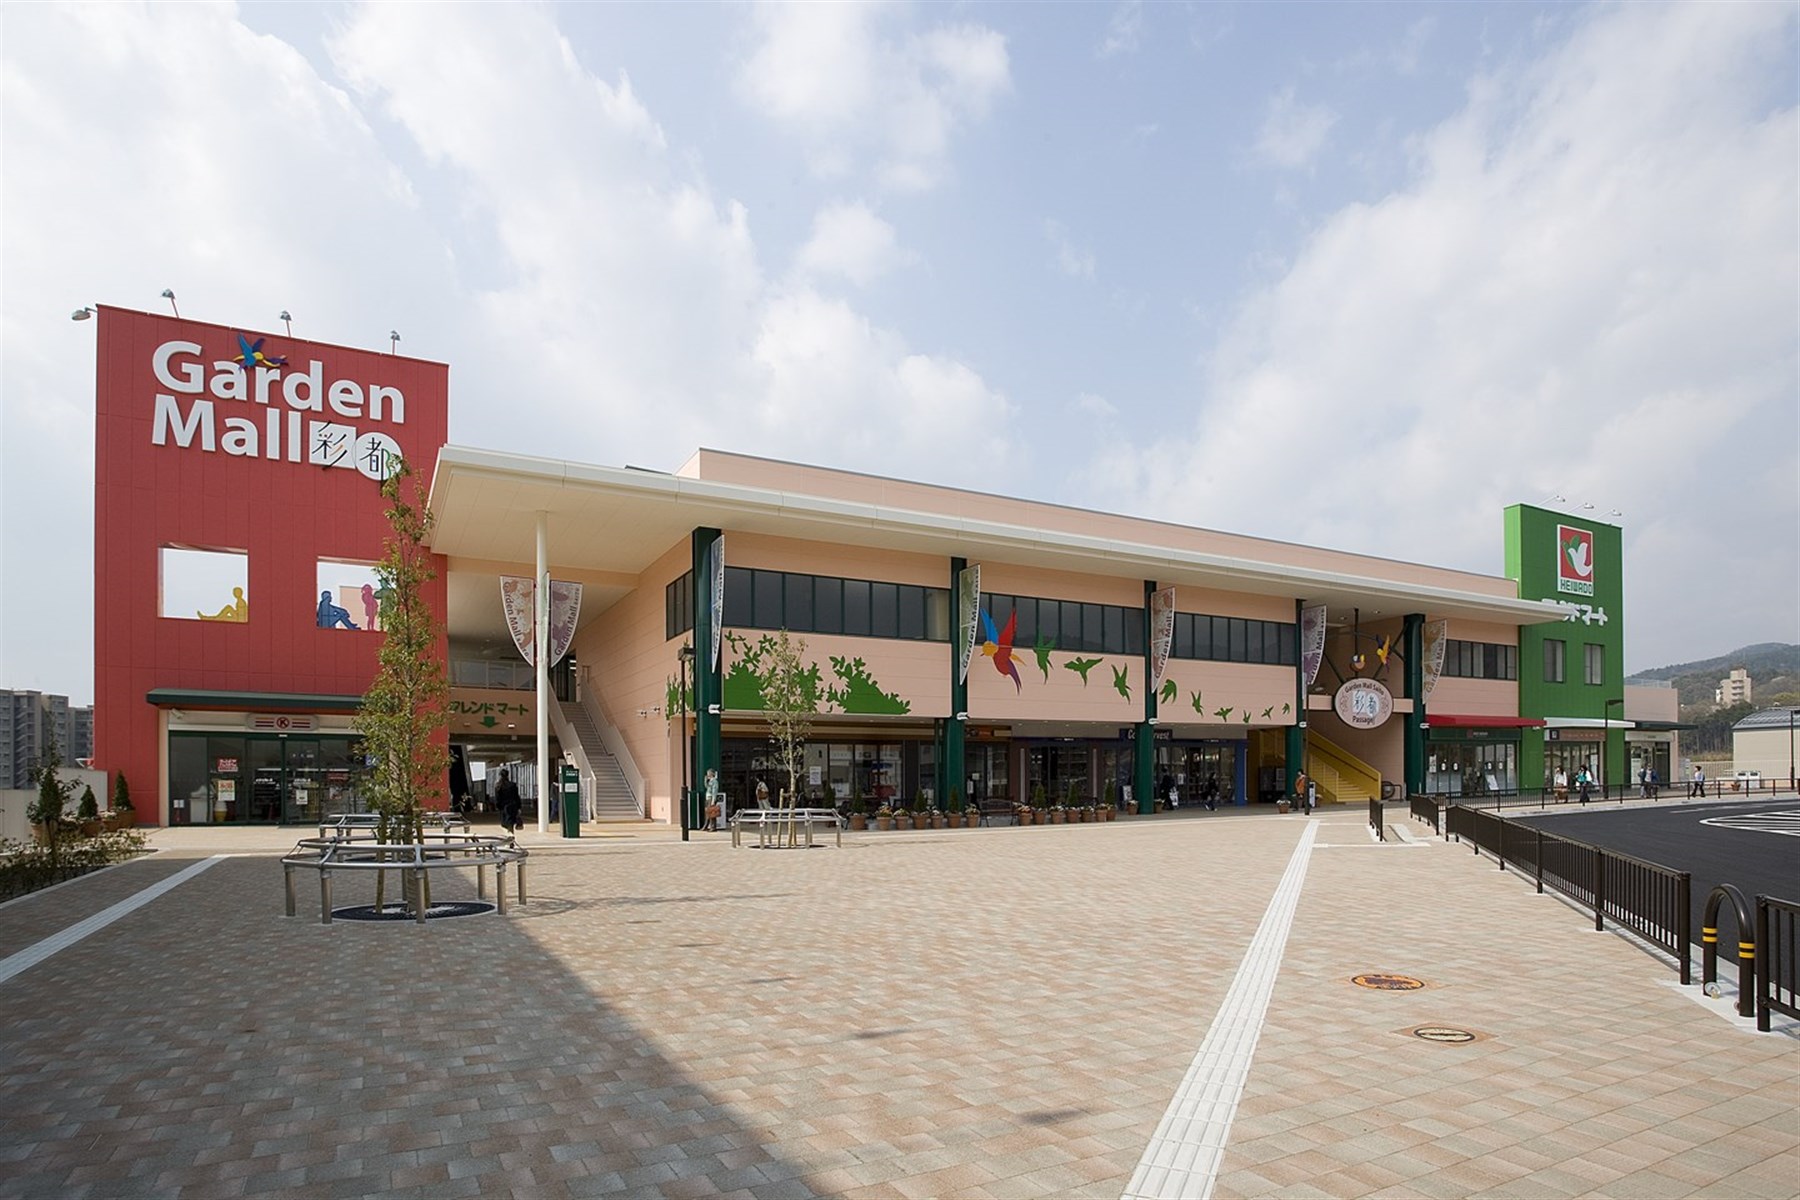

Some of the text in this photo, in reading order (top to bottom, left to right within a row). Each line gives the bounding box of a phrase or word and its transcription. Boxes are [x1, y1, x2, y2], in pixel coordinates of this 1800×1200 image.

[152, 340, 404, 424] Garden
[152, 393, 398, 486] Mall 彩都
[503, 581, 514, 615] Garden
[509, 617, 522, 636] Mall
[1561, 579, 1592, 595] HEIWADO
[555, 626, 574, 655] Garden
[567, 605, 577, 625] Mall
[963, 624, 976, 668] Garden
[1155, 640, 1170, 679] Garden
[1426, 662, 1441, 693] Garden
